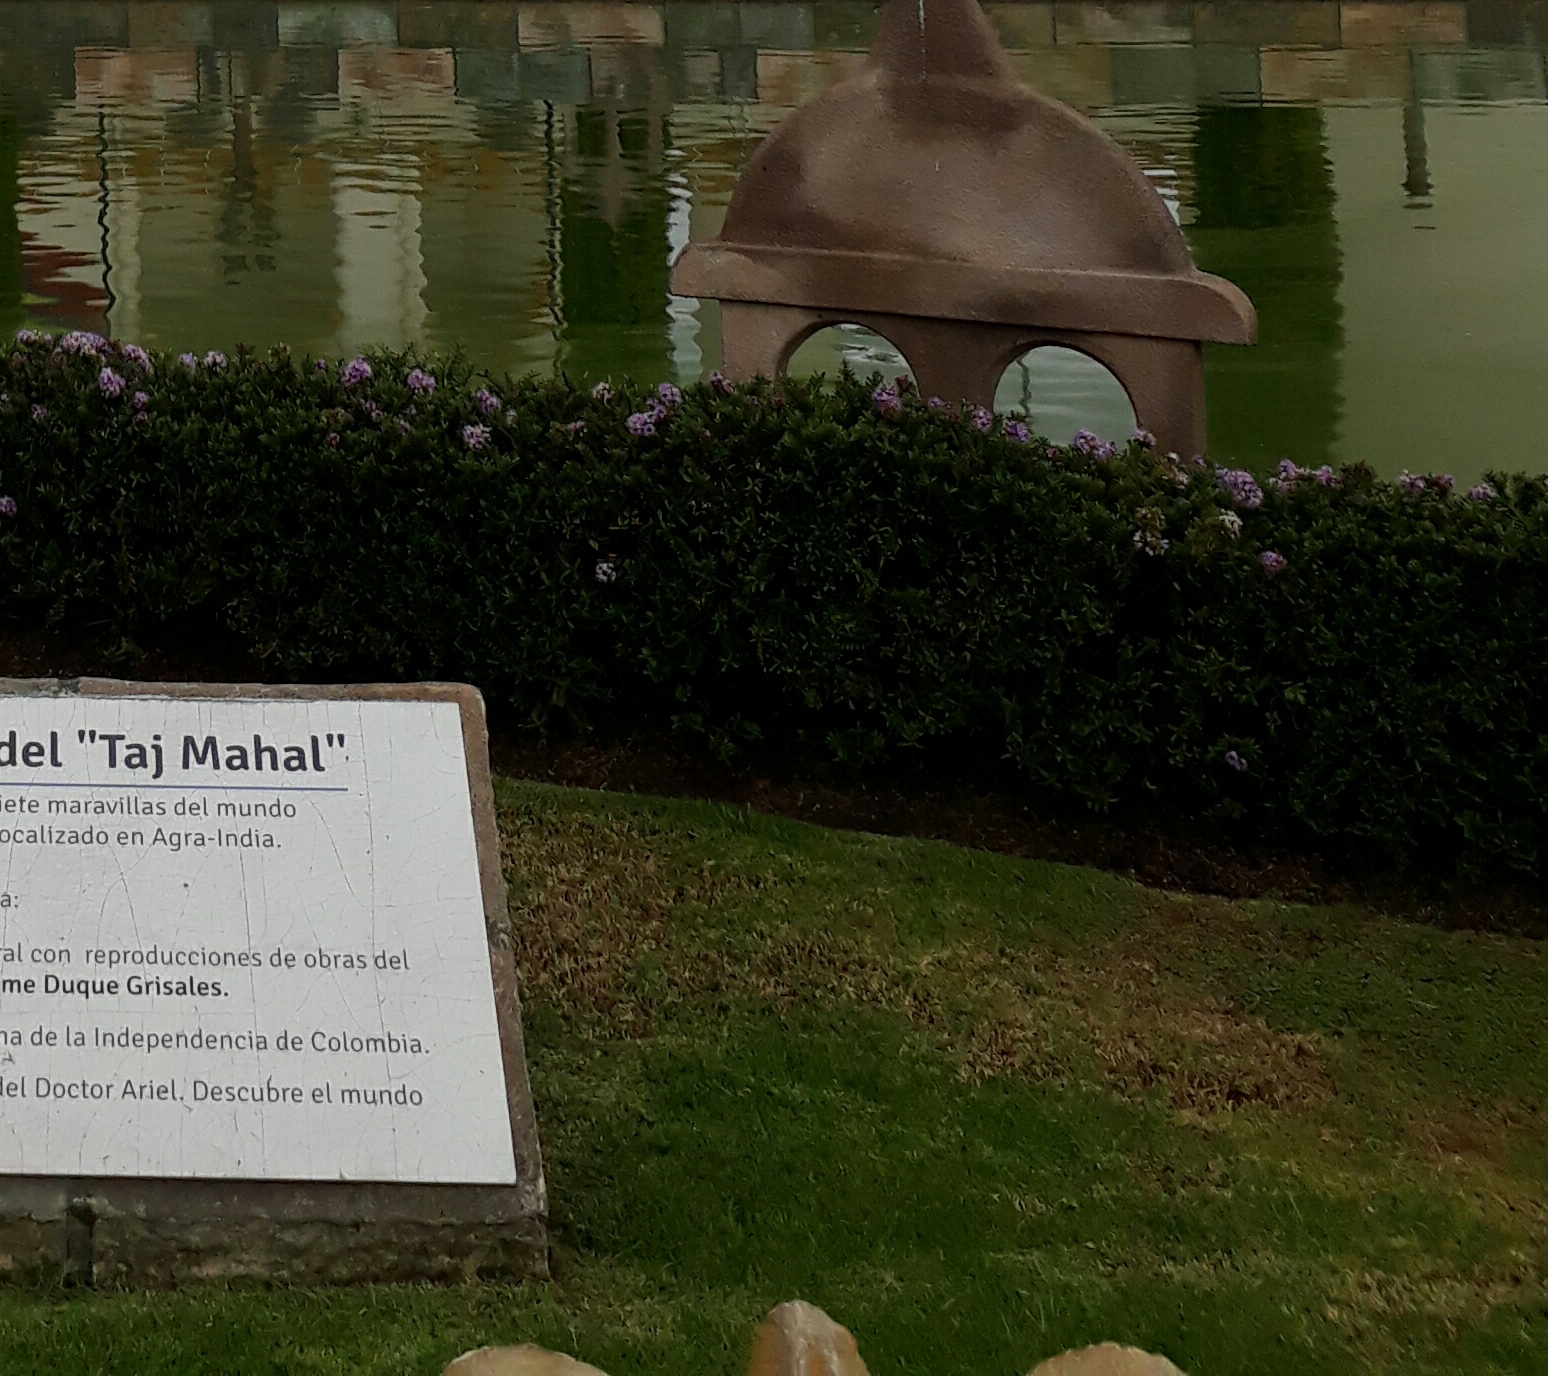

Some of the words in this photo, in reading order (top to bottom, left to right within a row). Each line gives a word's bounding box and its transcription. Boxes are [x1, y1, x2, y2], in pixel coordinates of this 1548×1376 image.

[77, 729, 164, 779] "Taj
[181, 733, 346, 772] Mahal"
[48, 796, 166, 816] maravillas
[174, 797, 209, 817] del
[217, 798, 296, 818] mundo
[117, 831, 144, 846] en
[152, 828, 282, 851] Agra-India.
[31, 948, 71, 963] con
[85, 944, 262, 968] reproducciones
[269, 948, 296, 968] de
[304, 949, 367, 969] obras
[374, 949, 410, 970] del
[44, 974, 119, 999] Duque
[127, 975, 229, 997] Grisales.
[30, 1025, 57, 1047] de
[66, 1027, 86, 1047] la
[95, 1028, 268, 1053] Independencia
[276, 1030, 303, 1051] de
[311, 1031, 430, 1054] Colombia.
[35, 1077, 114, 1099] Doctor
[121, 1079, 185, 1101] Ariel.
[193, 1080, 303, 1103] Descubre
[311, 1082, 332, 1104] el
[341, 1084, 423, 1106] mundo
